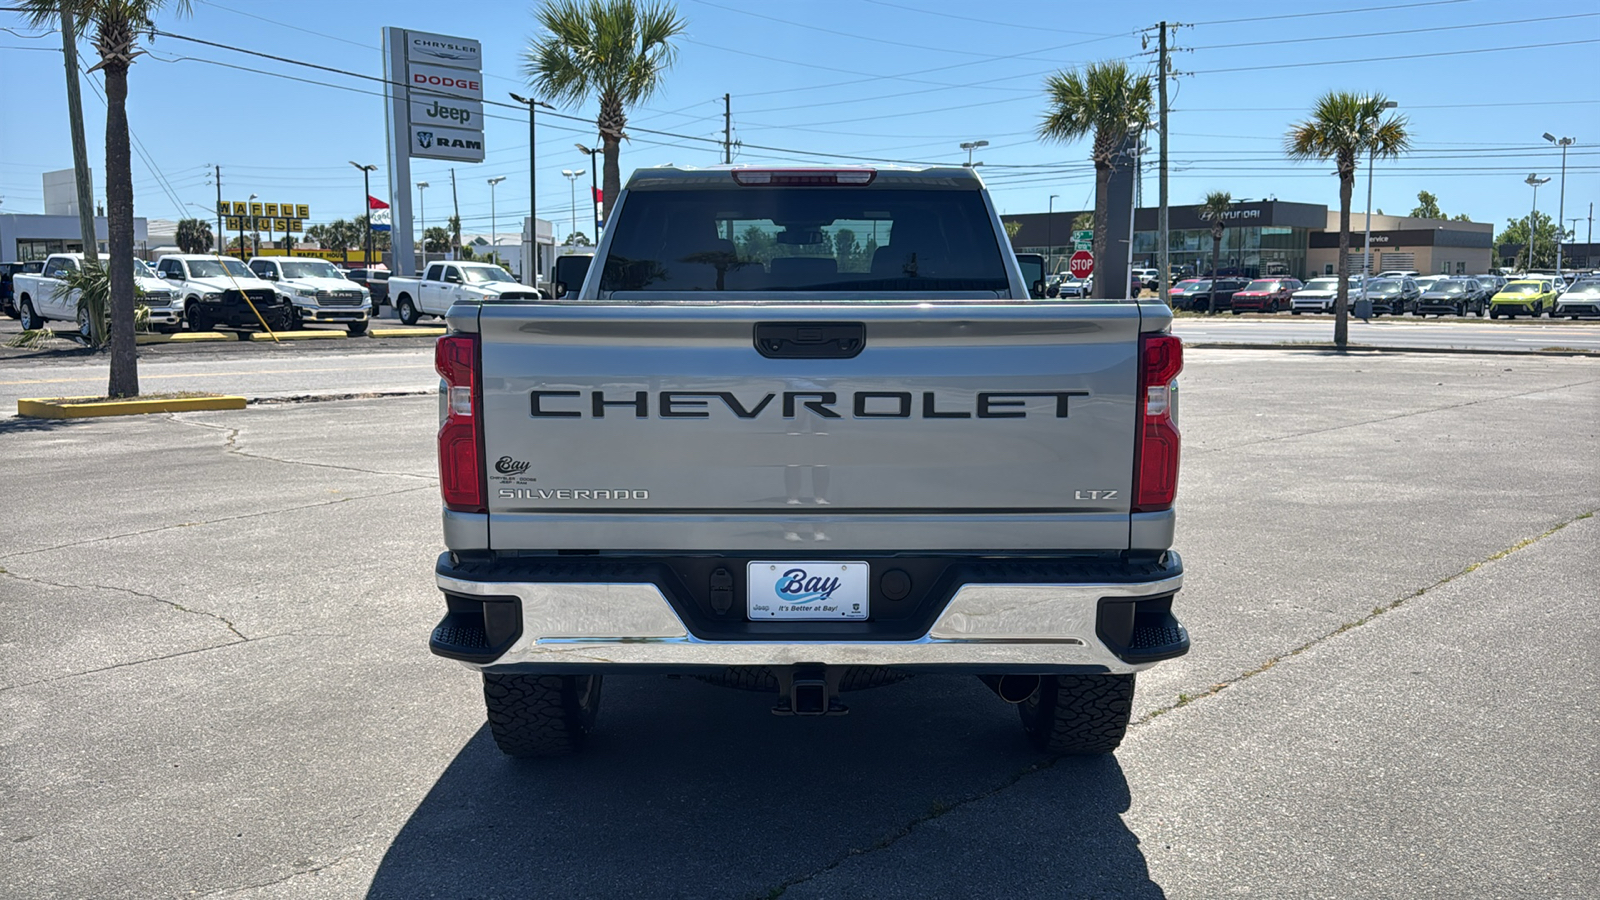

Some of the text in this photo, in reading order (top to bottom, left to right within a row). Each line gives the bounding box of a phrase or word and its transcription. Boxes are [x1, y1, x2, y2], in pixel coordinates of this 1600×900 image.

[414, 39, 477, 53] CHRYSLER
[414, 74, 480, 90] DODGE
[426, 101, 471, 124] Jeep
[437, 137, 482, 150] RAM
[220, 203, 309, 216] WAFFLE
[1369, 235, 1389, 243] ervice
[1071, 259, 1093, 271] STOP
[529, 390, 1089, 419] CHEVROLET
[500, 455, 532, 475] Bay
[498, 488, 650, 500] SILVERADO
[1074, 489, 1118, 500] LTZ
[780, 568, 842, 601] Bay
[753, 604, 770, 612] Jeep
[823, 605, 838, 613] Bay!
